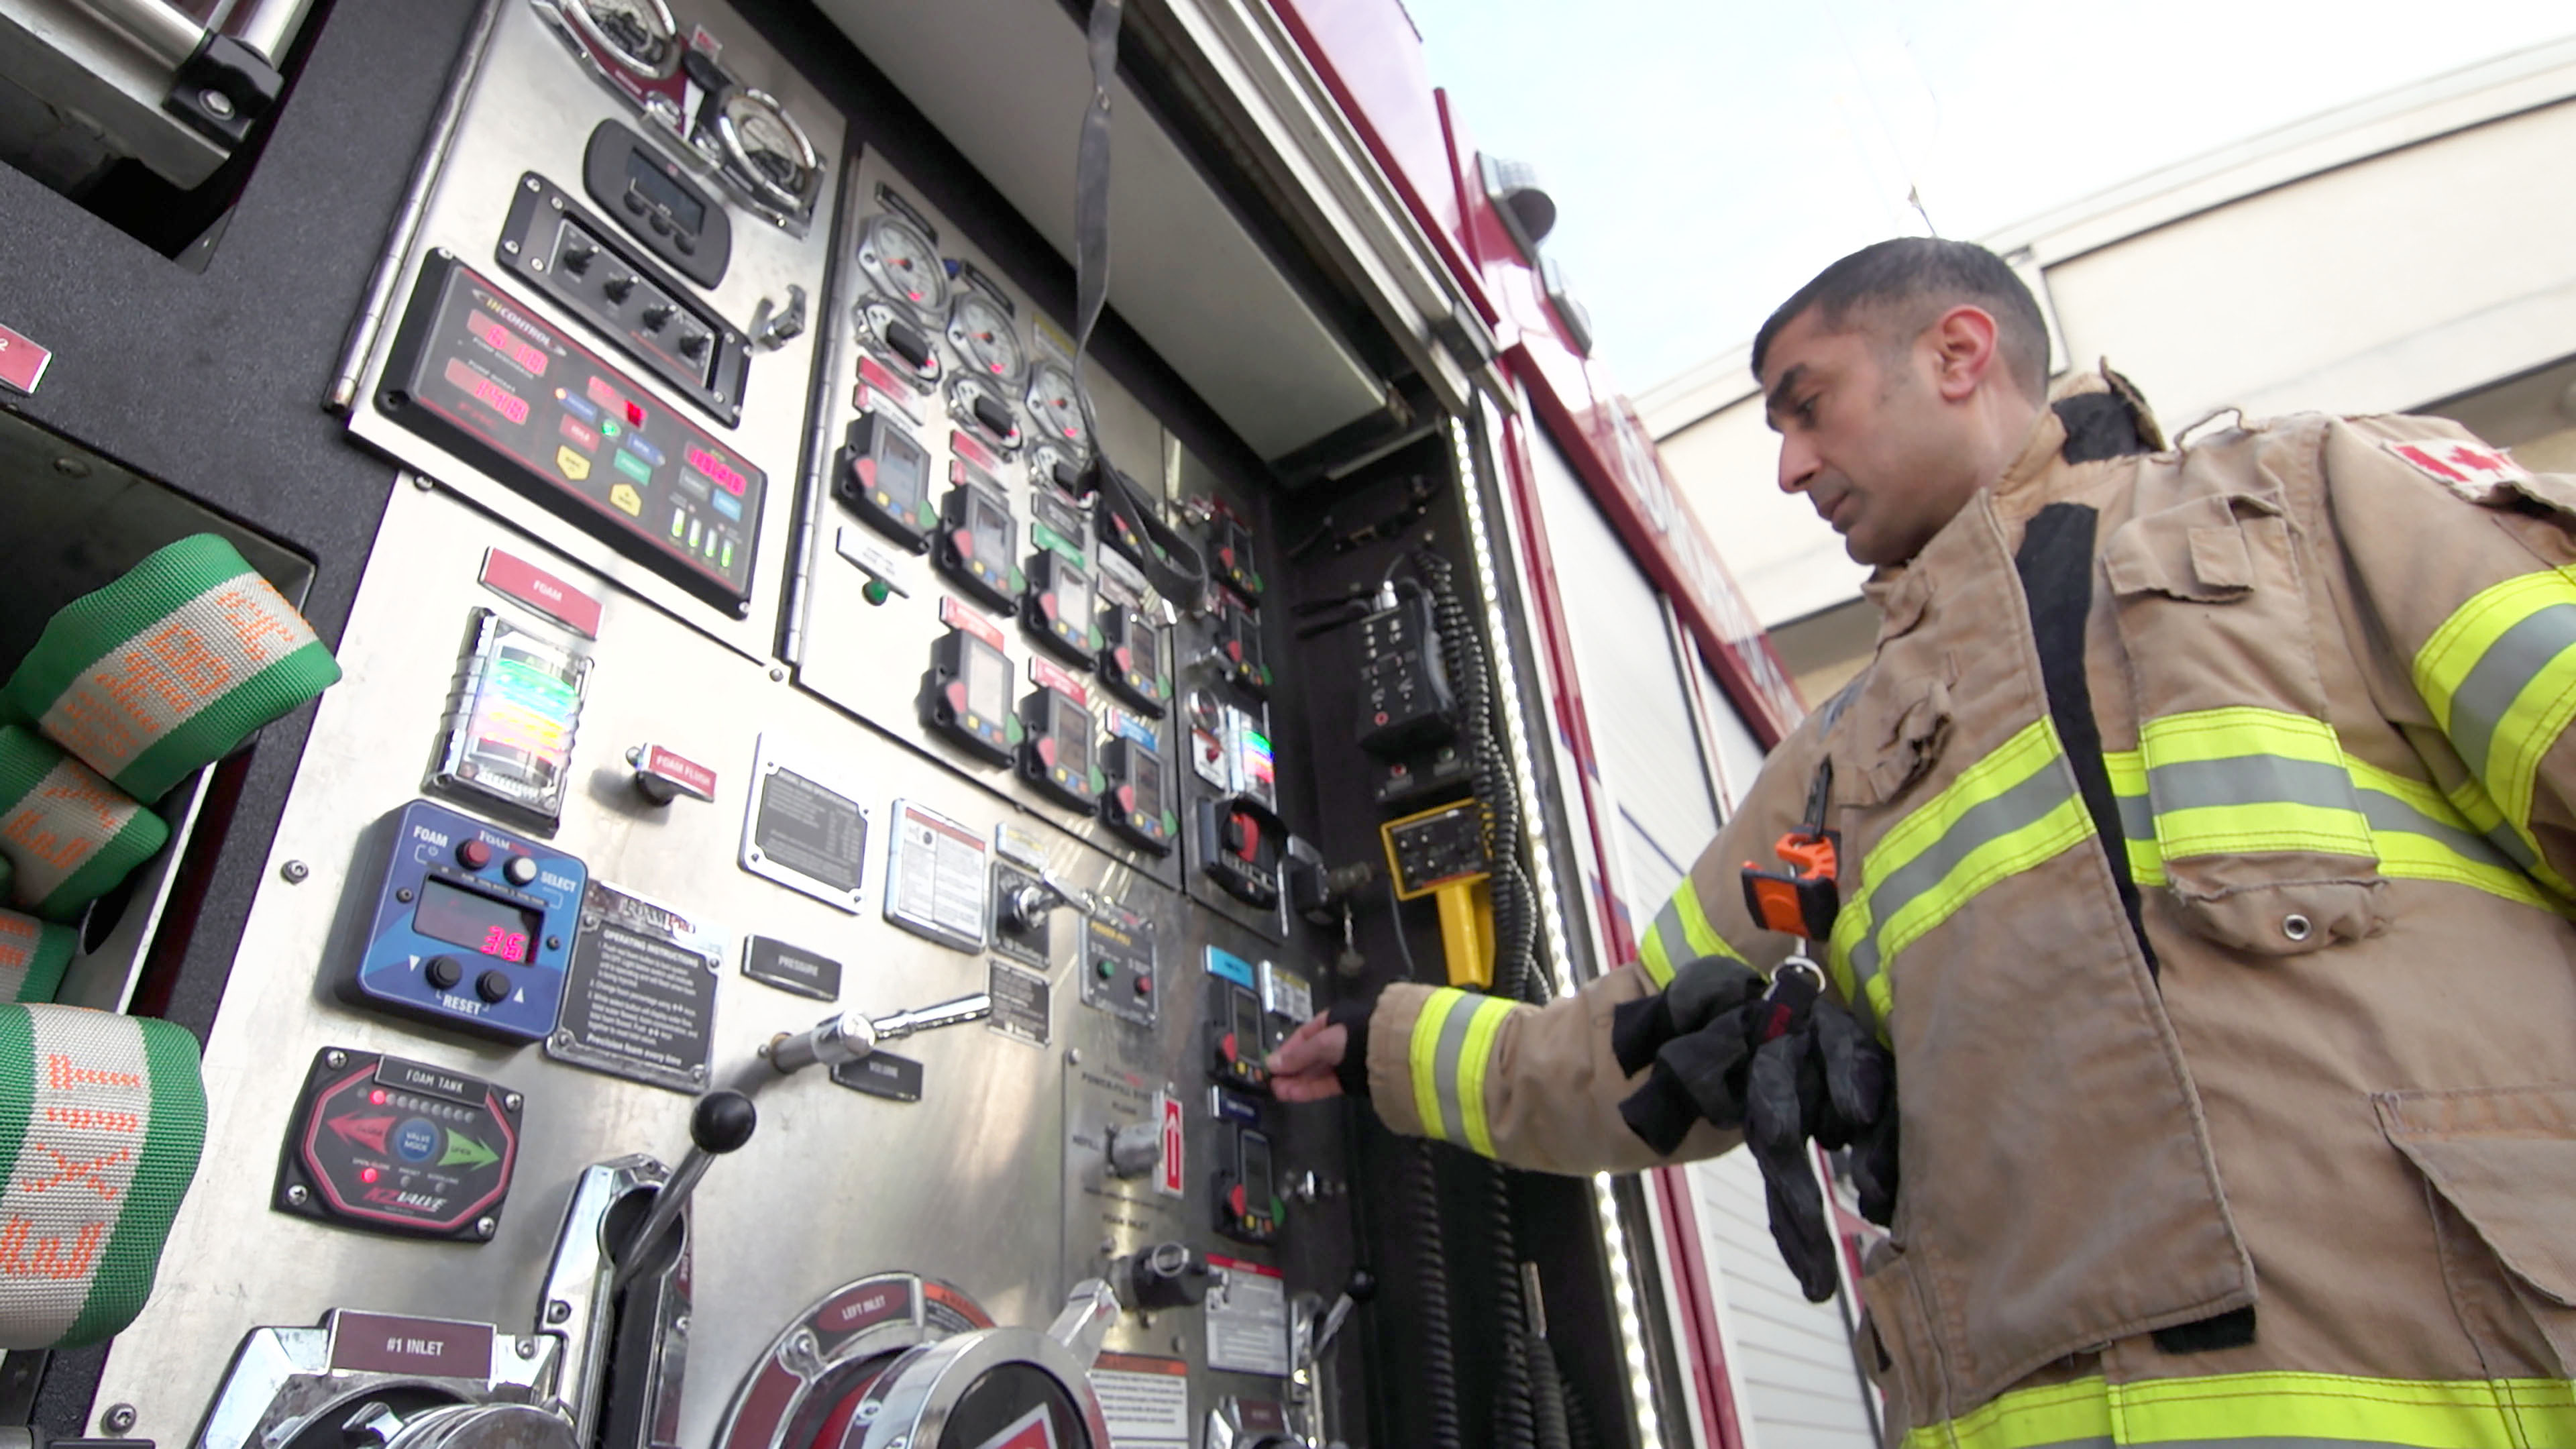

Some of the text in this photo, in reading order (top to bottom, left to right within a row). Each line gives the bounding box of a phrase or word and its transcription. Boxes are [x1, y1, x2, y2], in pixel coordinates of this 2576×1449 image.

[533, 580, 562, 602] FOAM
[655, 754, 683, 775] FOAM
[413, 826, 448, 847] FOAM
[541, 871, 577, 892] SELECT
[443, 995, 482, 1015] RESET
[406, 1069, 465, 1093] FOAM TANK
[841, 1303, 862, 1320] LEFT
[386, 1337, 444, 1356] #1 INLET
